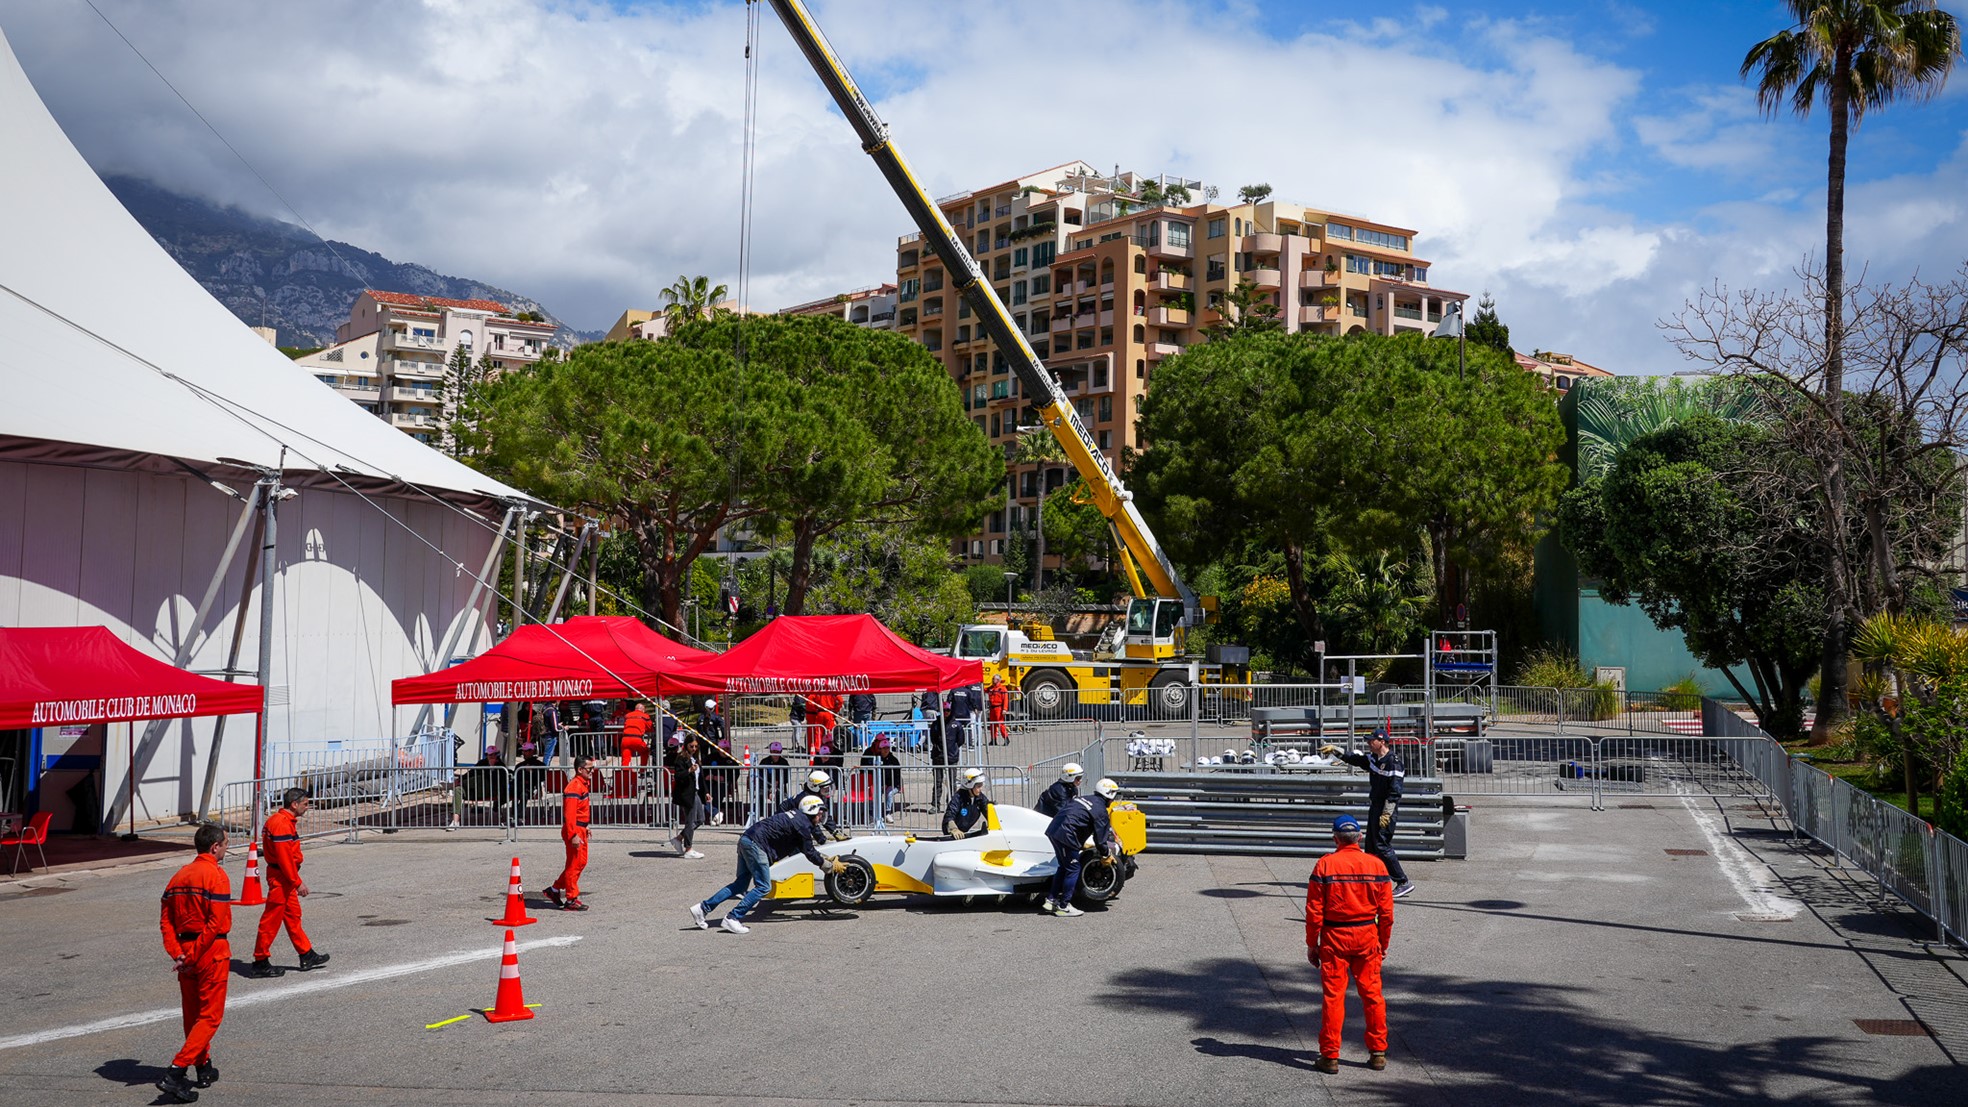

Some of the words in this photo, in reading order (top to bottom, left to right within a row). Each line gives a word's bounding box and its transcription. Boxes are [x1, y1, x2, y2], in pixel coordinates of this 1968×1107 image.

[455, 682, 513, 700] AUTOMOBILE
[514, 681, 538, 699] CLUB
[539, 680, 551, 698] DE
[552, 679, 592, 697] MONACO
[725, 677, 785, 693] AUTOMOBILE
[786, 677, 811, 692] CLUB
[813, 677, 827, 692] DE
[828, 674, 870, 692] MONACO
[32, 699, 105, 723] AUTOMOBILE
[106, 697, 134, 718] CLUB
[136, 696, 151, 716] DE
[151, 693, 196, 715] MONACO
